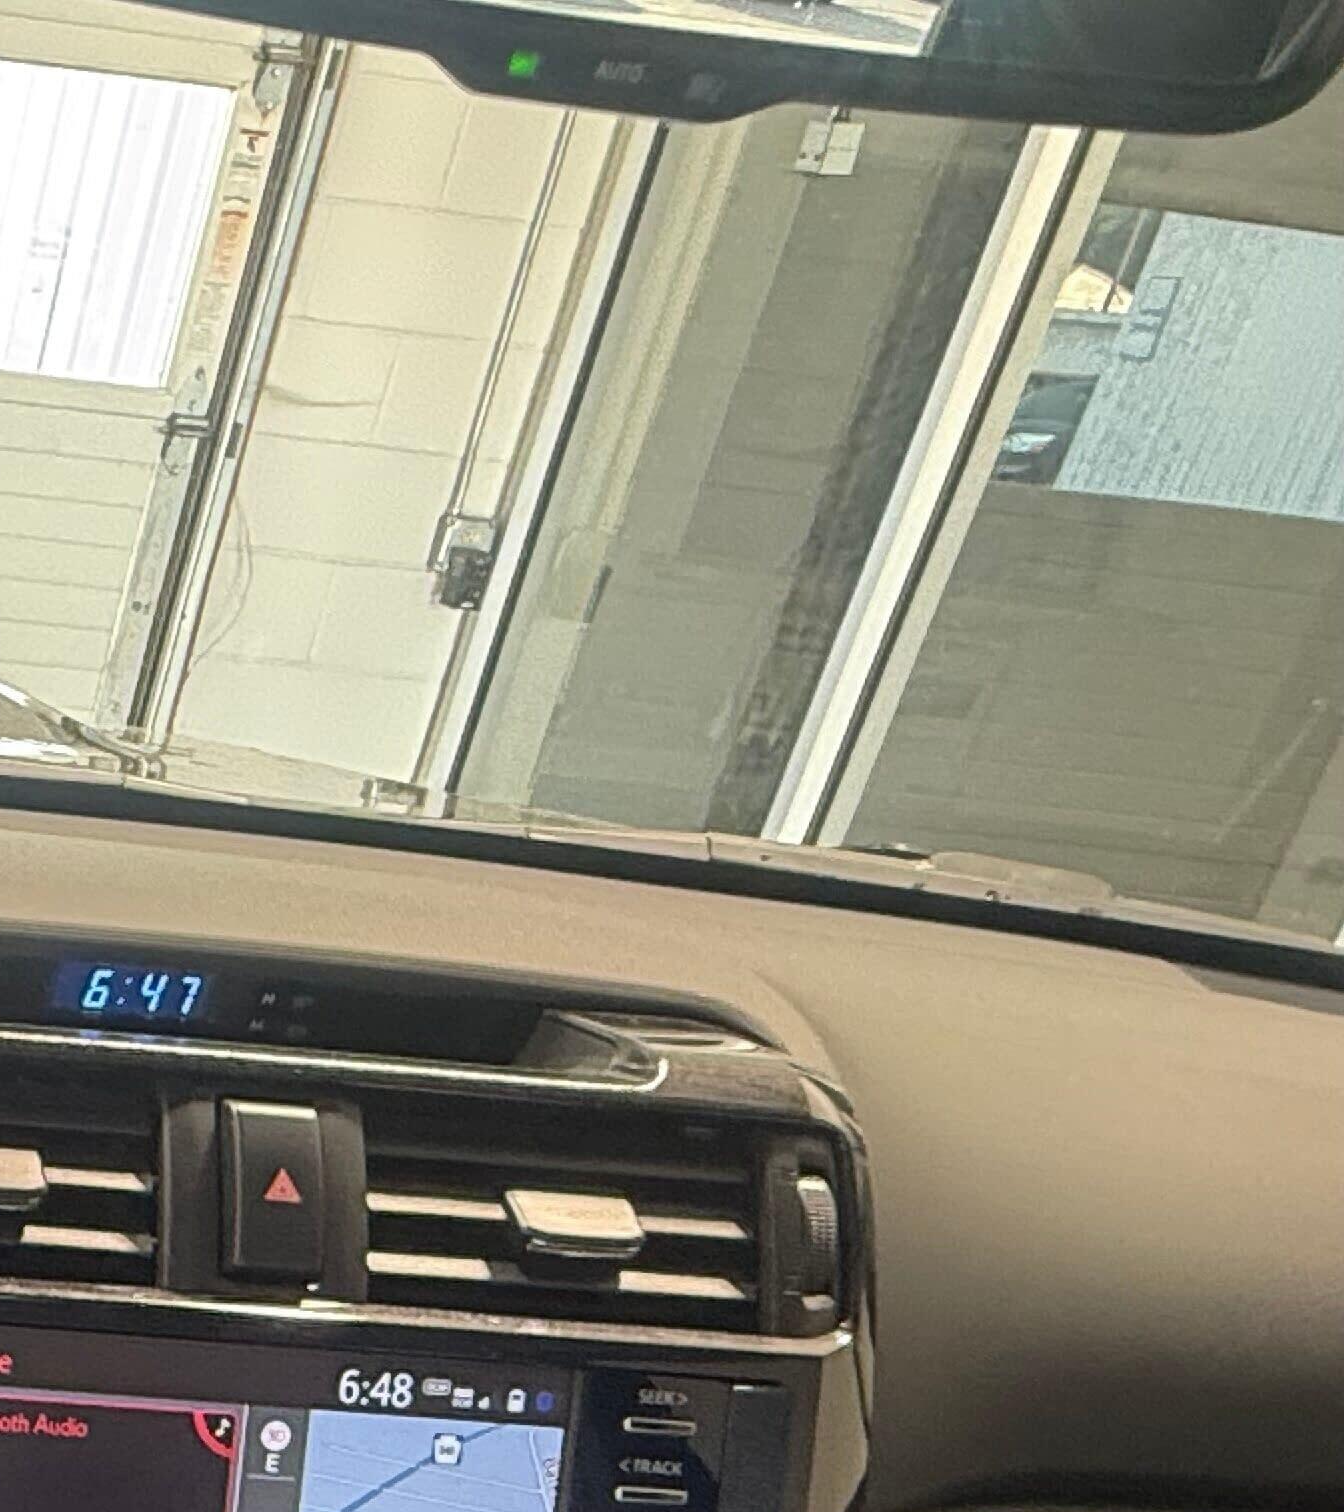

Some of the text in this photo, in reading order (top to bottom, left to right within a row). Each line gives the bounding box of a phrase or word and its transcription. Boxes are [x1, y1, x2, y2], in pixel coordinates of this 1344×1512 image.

[80, 968, 203, 1017] 6:47
[338, 1367, 414, 1409] 6:48
[33, 1412, 90, 1438] Audio
[266, 1453, 281, 1473] E
